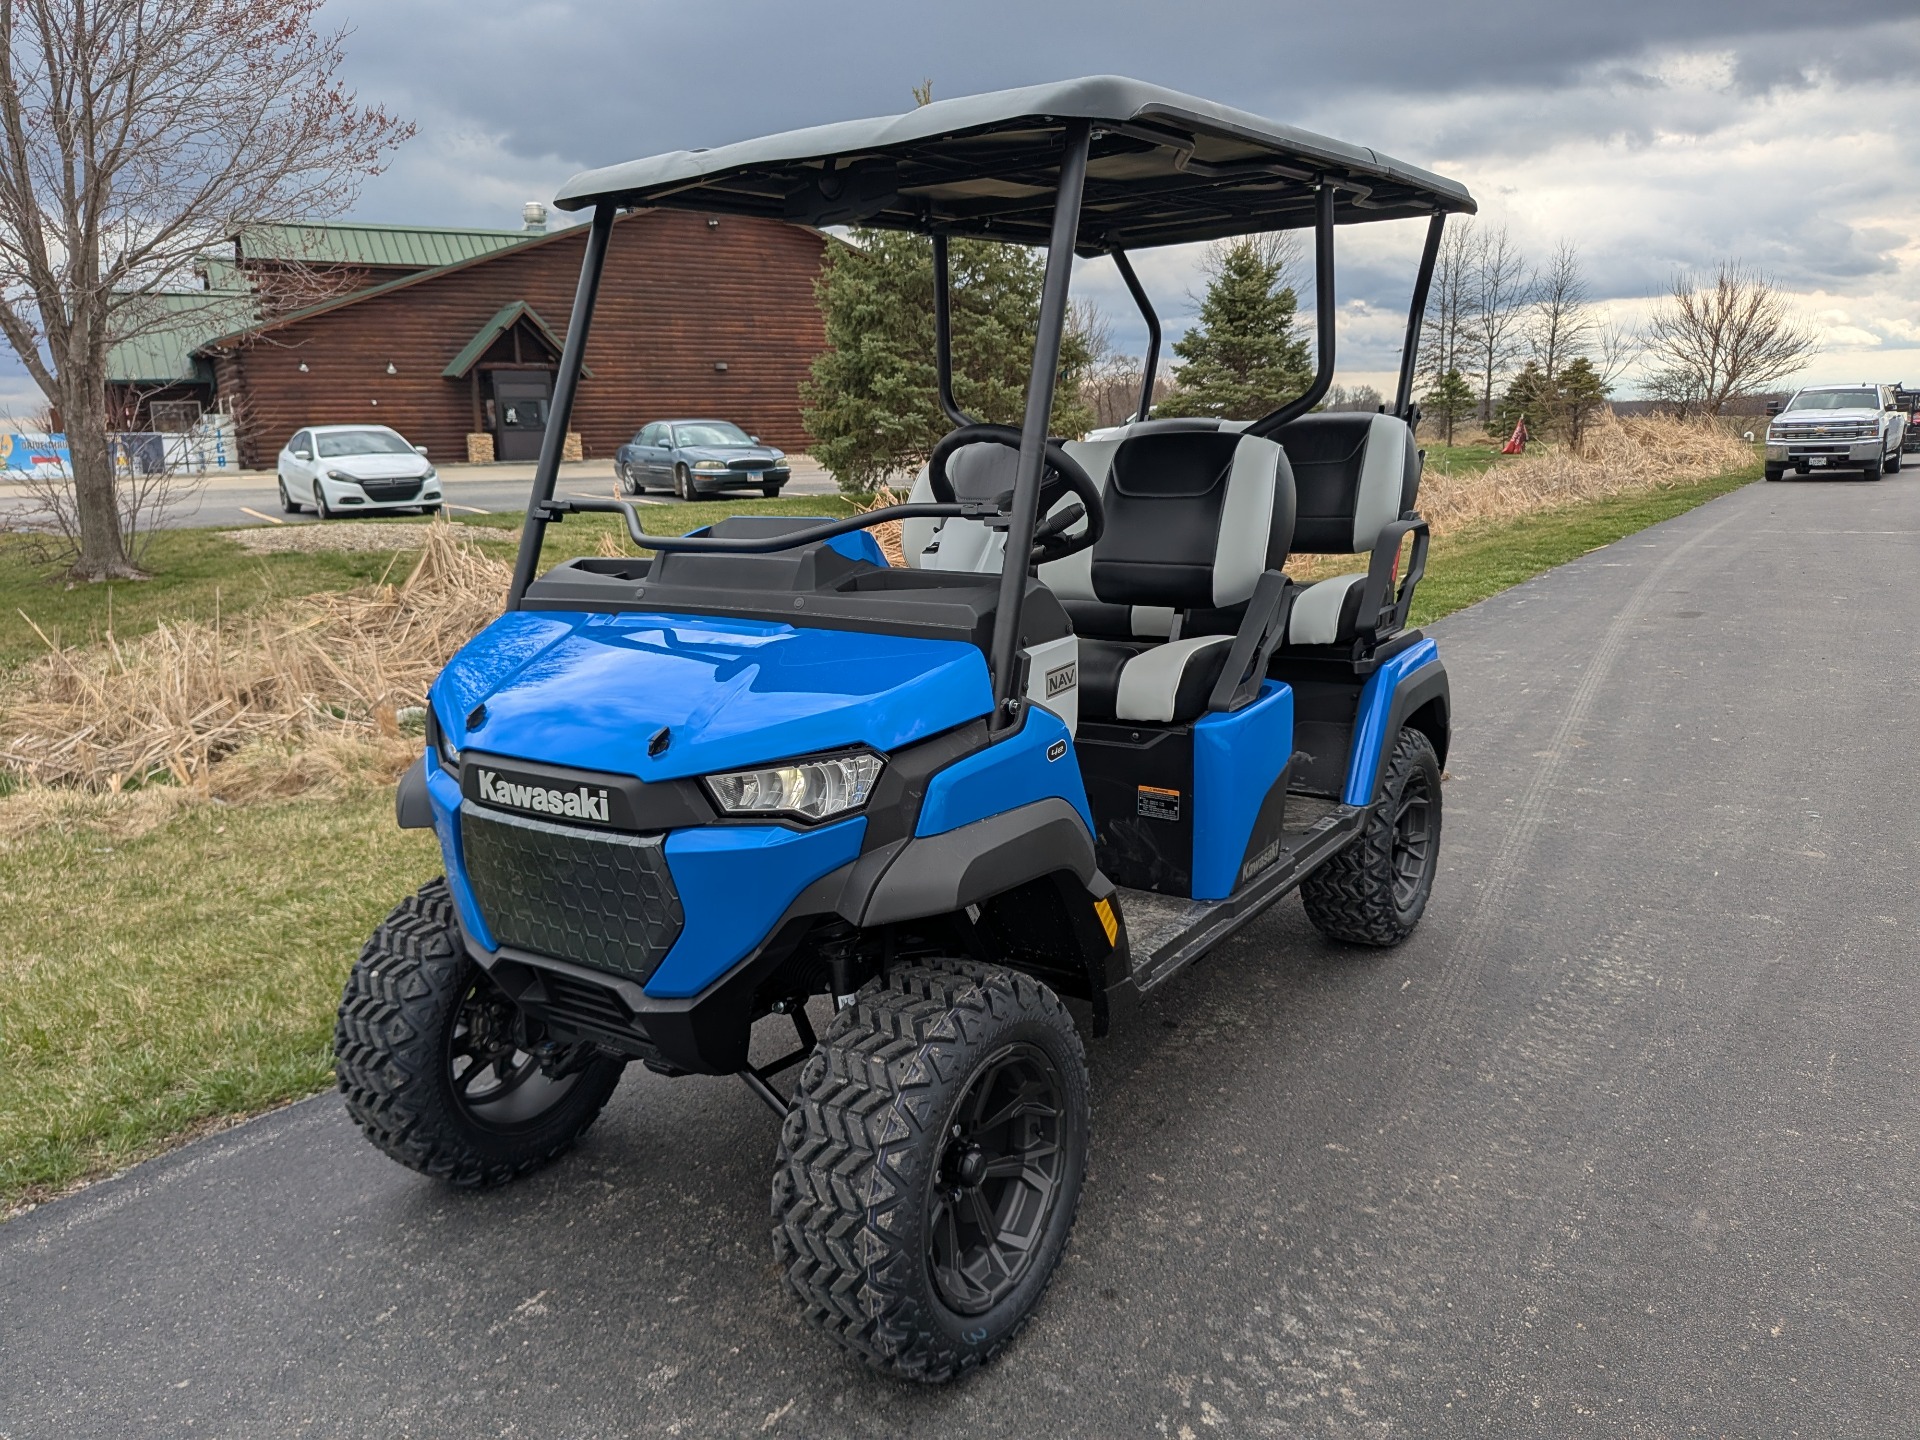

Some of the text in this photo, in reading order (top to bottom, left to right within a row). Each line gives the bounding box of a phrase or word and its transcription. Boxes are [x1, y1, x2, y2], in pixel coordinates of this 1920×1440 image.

[1049, 669, 1075, 692] NAV
[478, 769, 610, 821] Kawasaki
[1242, 838, 1280, 883] Kawasaki
